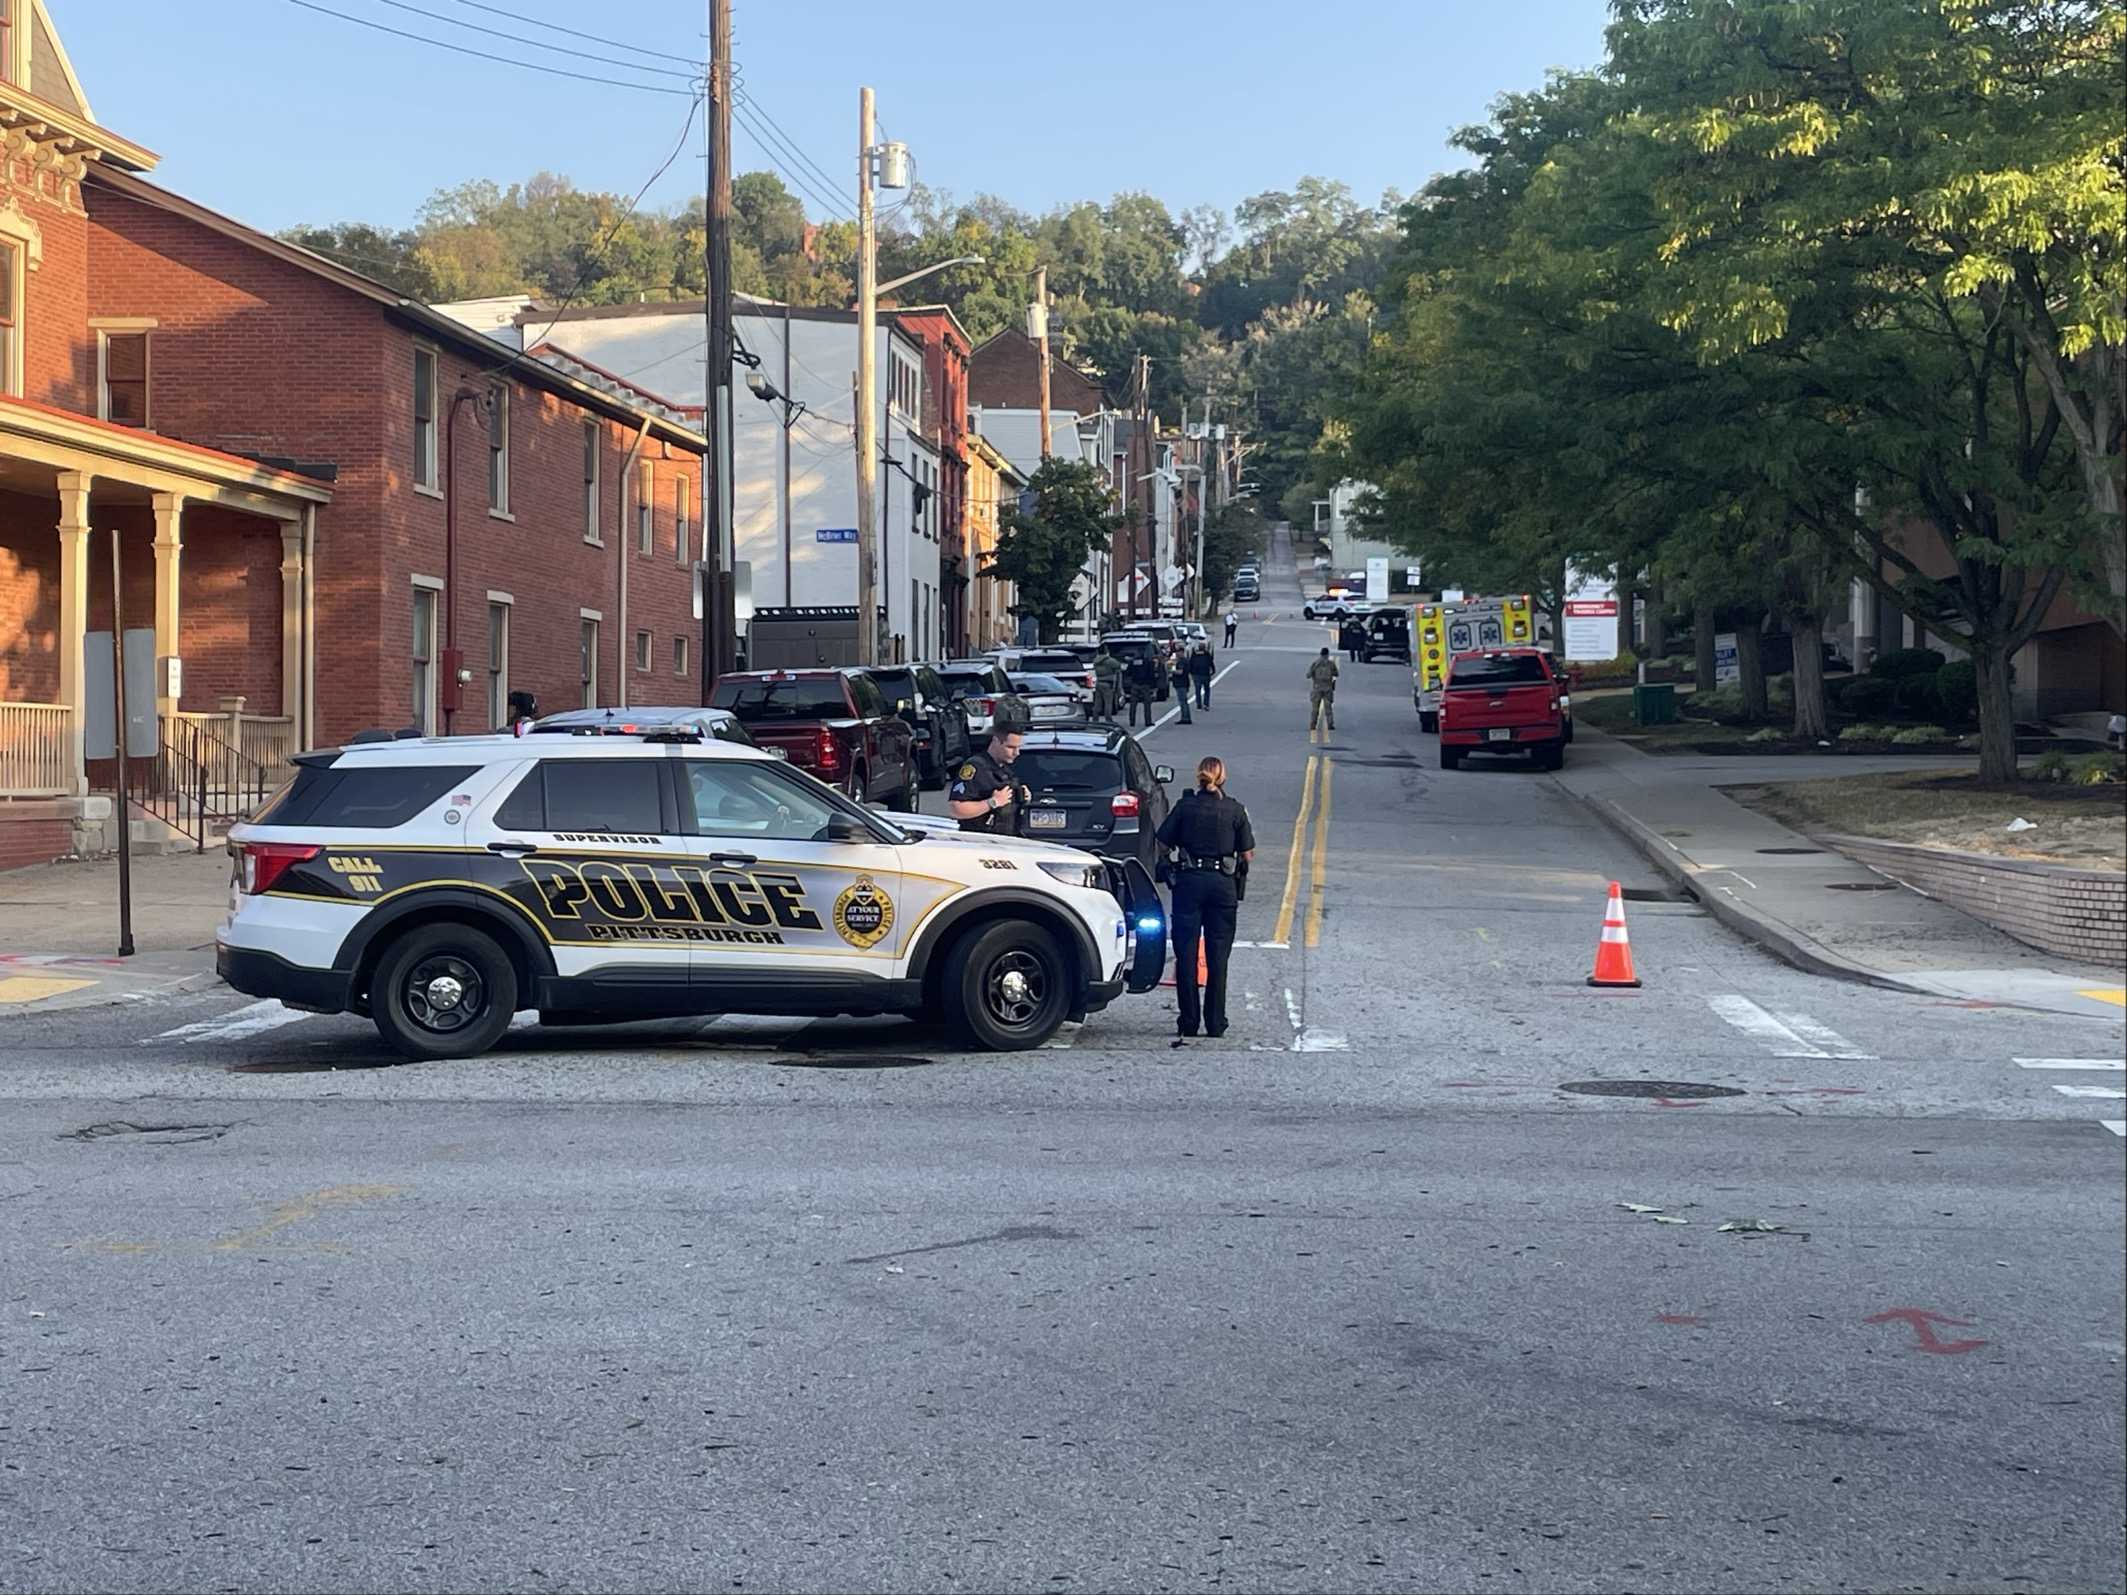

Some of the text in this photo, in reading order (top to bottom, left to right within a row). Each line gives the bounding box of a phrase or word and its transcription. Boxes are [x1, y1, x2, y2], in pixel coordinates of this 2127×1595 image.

[554, 834, 663, 845] SUPERVISOR
[328, 856, 384, 873] CALL
[348, 875, 383, 892] 911
[519, 858, 824, 931] POLICE
[847, 914, 880, 922] SERVICE
[586, 924, 785, 945] PITTSBURGH
